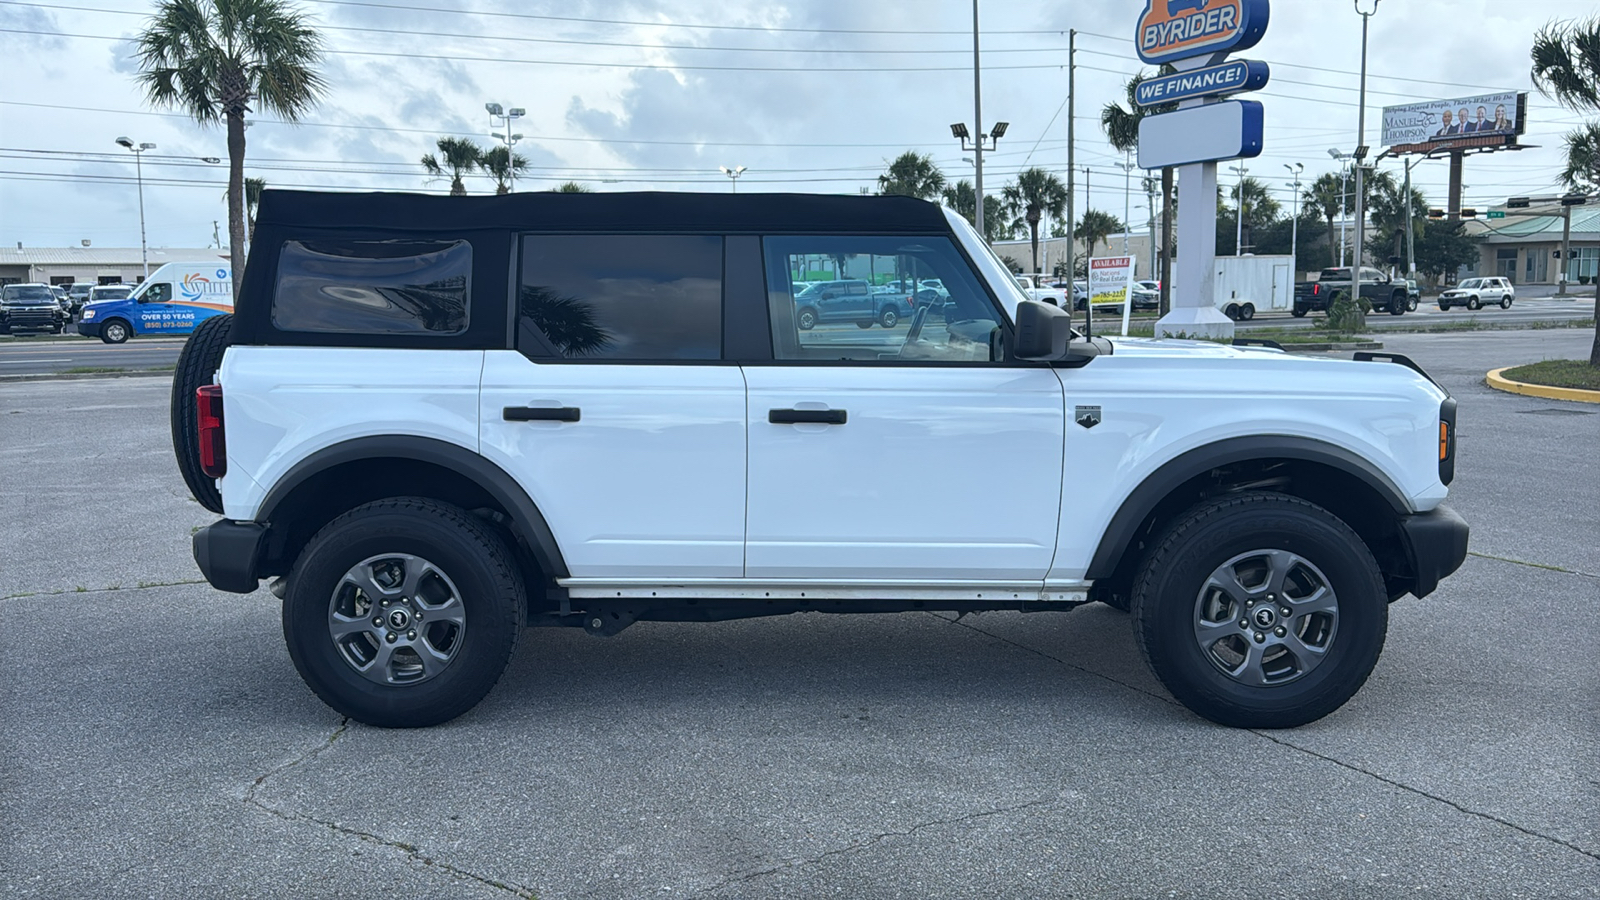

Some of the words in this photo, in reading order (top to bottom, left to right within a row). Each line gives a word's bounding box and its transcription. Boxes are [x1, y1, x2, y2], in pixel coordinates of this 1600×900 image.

[1143, 5, 1236, 49] BYRIDER
[1141, 83, 1164, 99] WE
[1166, 67, 1242, 94] FINANCE!
[1384, 117, 1418, 128] MANUEL
[1384, 128, 1426, 139] THOMPSON
[1092, 258, 1129, 268] AVAILABLE
